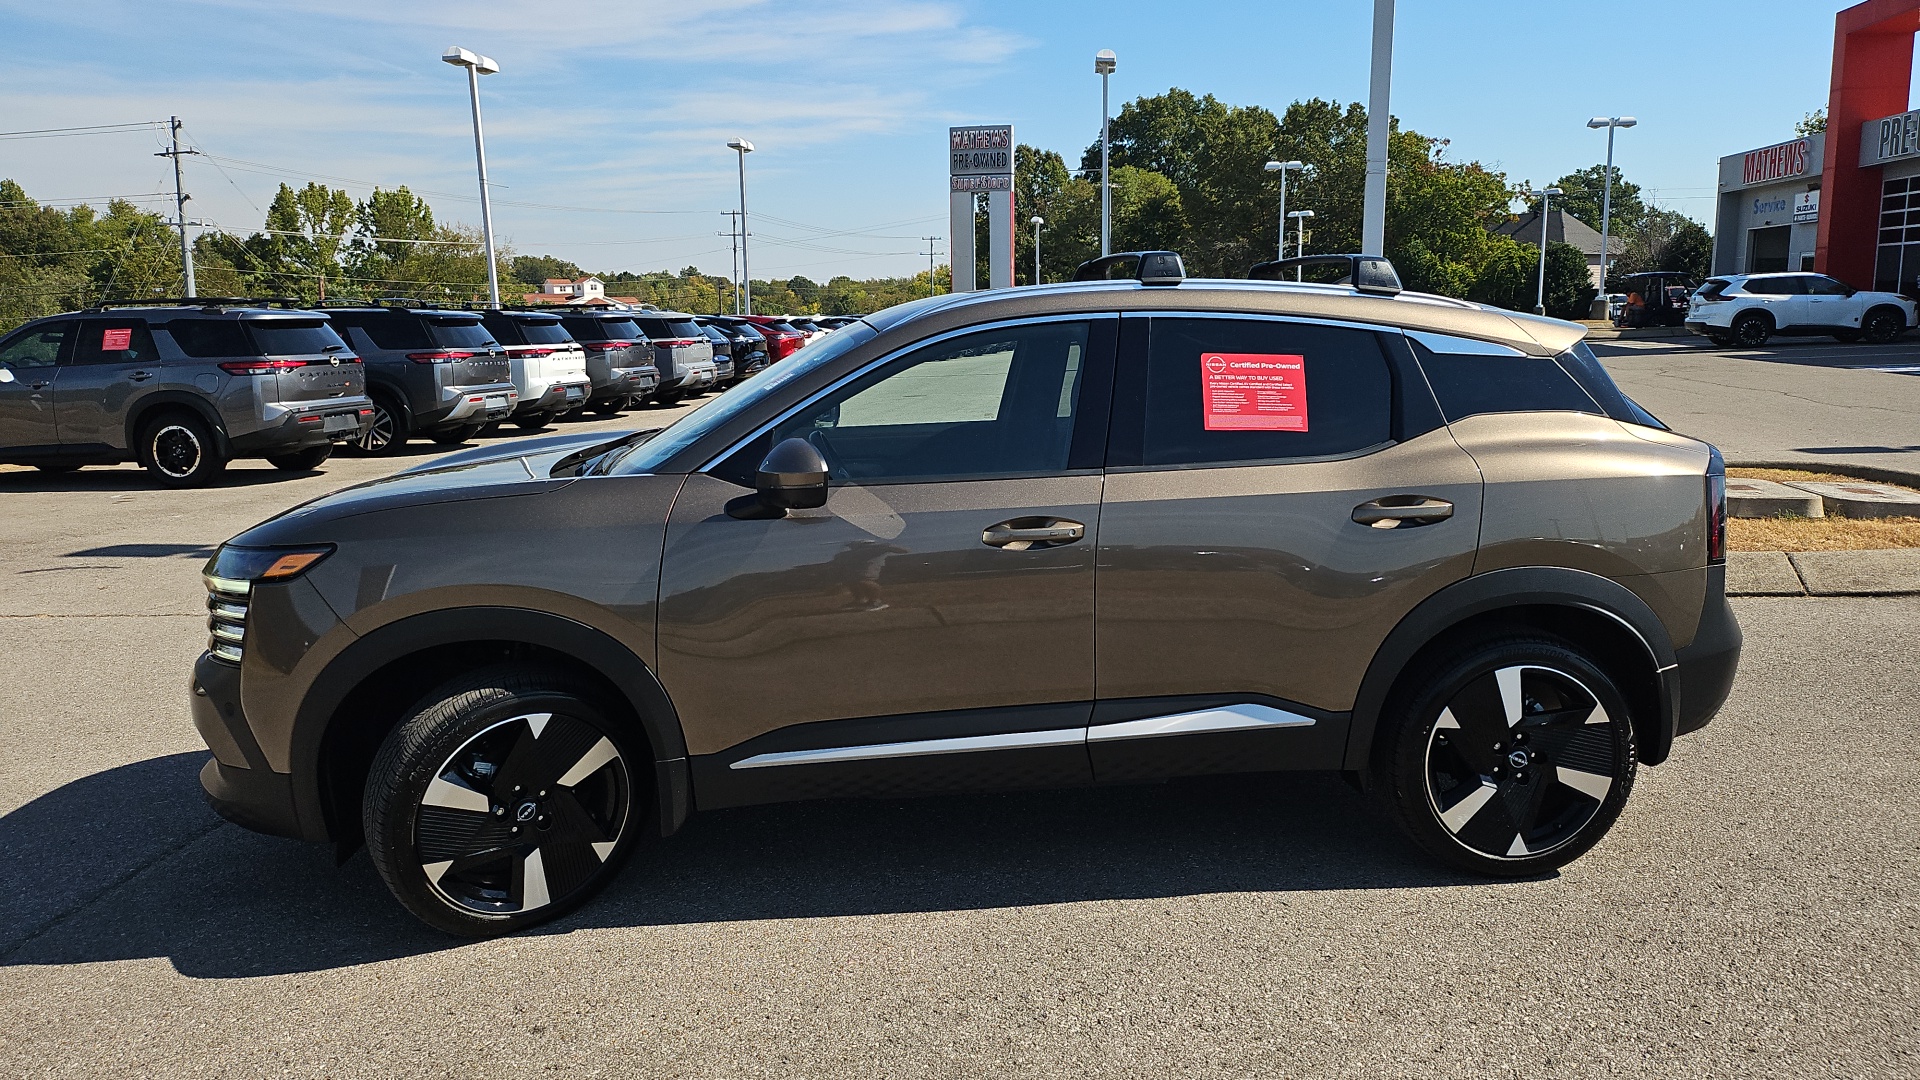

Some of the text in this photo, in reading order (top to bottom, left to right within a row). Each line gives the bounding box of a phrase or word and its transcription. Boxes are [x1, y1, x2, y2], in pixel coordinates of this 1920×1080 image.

[952, 129, 1008, 149] MATHEWS
[953, 152, 1007, 169] PRE-OWNED
[1742, 139, 1808, 186] MATHEWS
[1753, 195, 1787, 215] Service
[1796, 204, 1817, 213] SUZUKI
[1261, 362, 1301, 370] Pre-Owned
